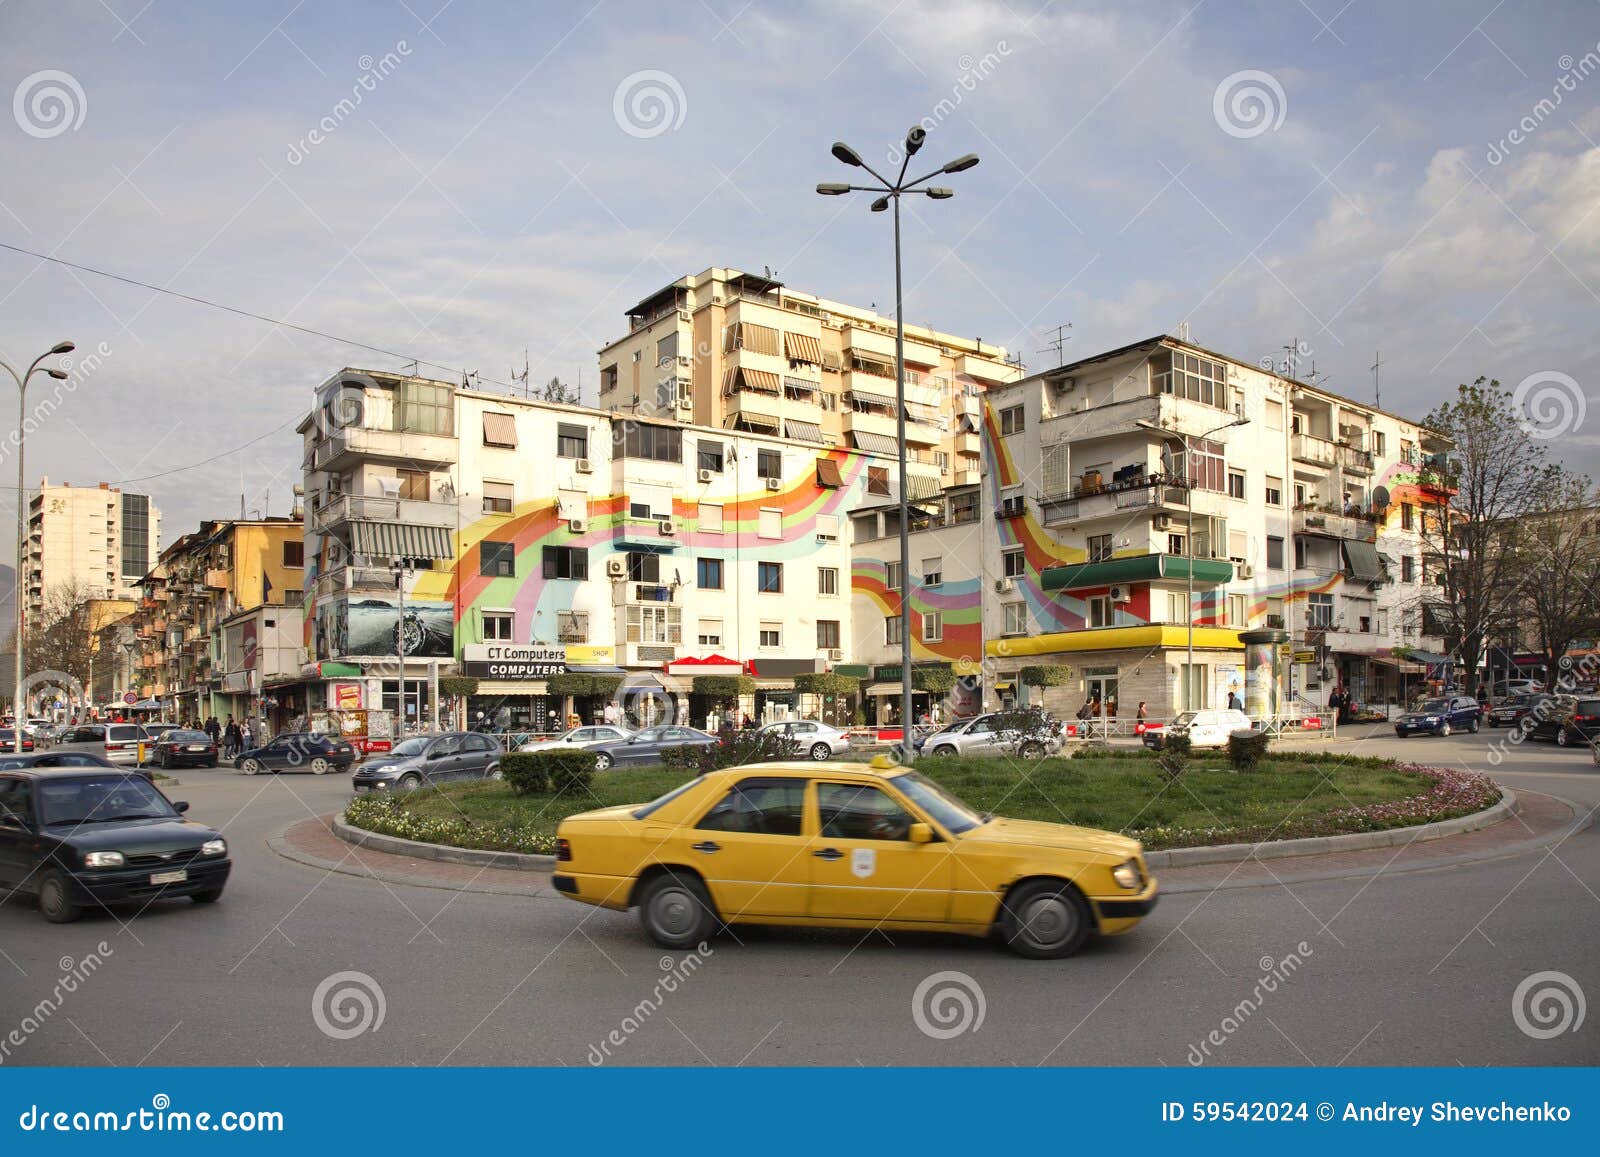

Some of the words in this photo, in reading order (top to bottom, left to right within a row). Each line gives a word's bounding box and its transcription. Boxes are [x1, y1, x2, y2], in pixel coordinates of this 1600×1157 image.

[488, 647, 501, 660] CT
[504, 647, 566, 661] Computers
[489, 664, 565, 675] COMPUTERS
